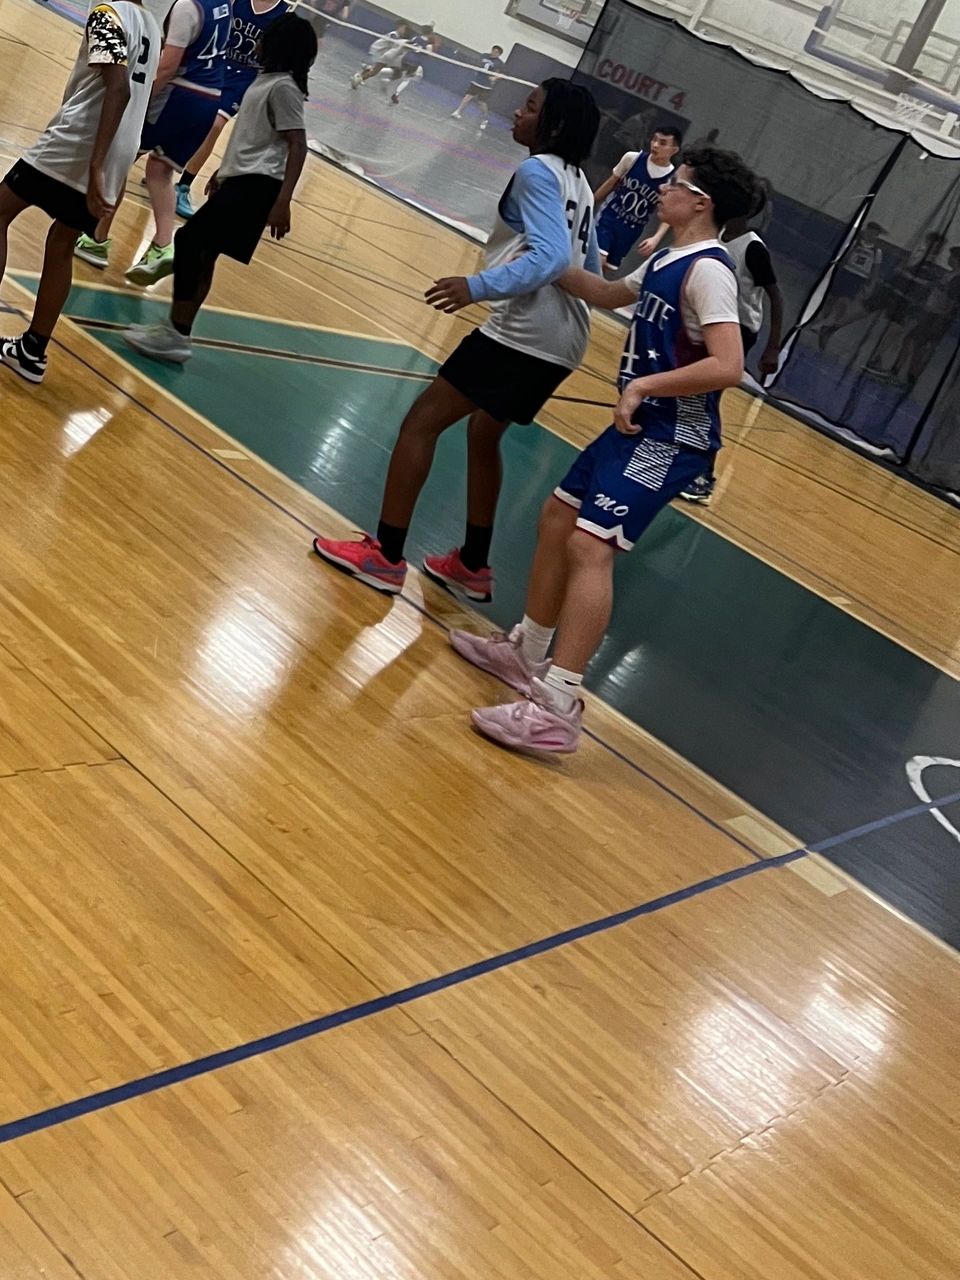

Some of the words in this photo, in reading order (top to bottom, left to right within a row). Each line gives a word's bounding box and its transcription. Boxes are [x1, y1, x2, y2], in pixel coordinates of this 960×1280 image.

[596, 58, 668, 101] COURT
[669, 91, 686, 110] 4
[593, 493, 630, 517] MO
